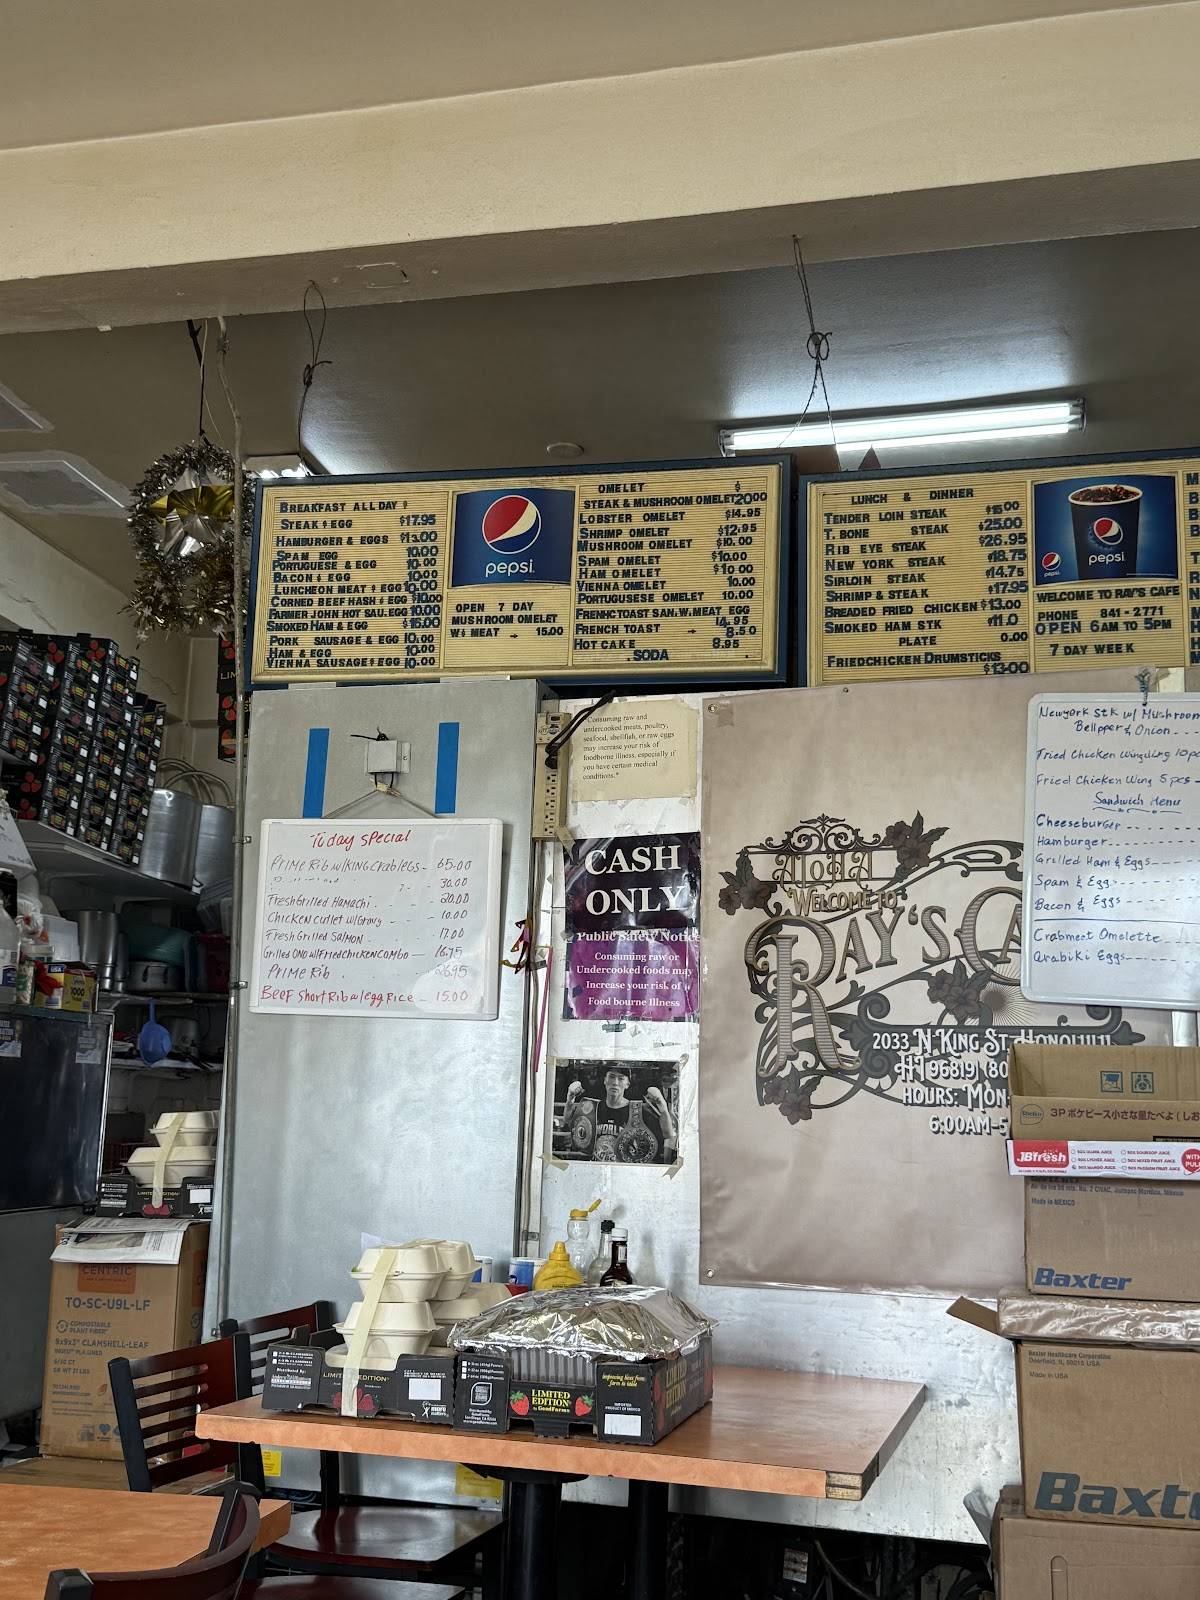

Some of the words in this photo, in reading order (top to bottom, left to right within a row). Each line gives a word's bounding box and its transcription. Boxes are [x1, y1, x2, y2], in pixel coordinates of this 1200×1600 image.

[598, 483, 645, 493] OMELET
[851, 495, 887, 505] LUNCH
[903, 493, 911, 501] &
[930, 488, 974, 500] DINNER
[280, 502, 346, 513] BREAKFAST
[353, 503, 375, 511] ALL
[378, 501, 398, 510] DAY
[281, 519, 319, 529] STEAK
[331, 520, 352, 528] EGG
[400, 514, 436, 526] $17.95
[580, 514, 632, 524] LOBSTER
[643, 512, 685, 521] OMELET
[725, 508, 760, 519] $14.95
[824, 513, 869, 524] TENDER
[879, 512, 903, 521] LOIN
[910, 509, 947, 519] STEAK
[580, 528, 622, 538] SHRIMP
[629, 528, 669, 536] OMELET
[718, 524, 757, 535] $12.95
[276, 536, 343, 547] HAMBURGER
[360, 535, 388, 544] EGGS
[577, 541, 643, 551] MUSHROOM
[649, 539, 692, 549] OMELET
[825, 544, 850, 555] RIB
[860, 544, 883, 553] EYE
[892, 542, 926, 552] STEAK
[979, 533, 1027, 547] $26.95
[825, 559, 854, 571] NEW
[863, 559, 894, 569] YORK
[908, 557, 945, 567] STEAK
[1089, 552, 1125, 565] pepsi
[486, 559, 533, 577] pepsi
[577, 581, 619, 592] VIENNA
[624, 581, 666, 591] OMELET
[727, 576, 755, 586] 10.00
[1037, 591, 1093, 602] WELCOME
[1100, 590, 1111, 599] TO
[1115, 588, 1146, 598] RAY'S
[1150, 586, 1180, 597] CAFE
[456, 604, 484, 612] OPEN
[499, 603, 504, 611] 7
[513, 602, 534, 611] DAY
[825, 606, 875, 617] BREADED
[882, 605, 913, 615] FRIED
[924, 602, 977, 613] CHICKEN
[452, 616, 513, 625] MUSHROOM
[518, 614, 557, 624] OMELET
[1038, 610, 1078, 621] PHONE
[576, 624, 619, 634] FRENCH
[624, 624, 660, 633] TOAST
[1035, 621, 1081, 635] OPEN
[1090, 620, 1118, 632] 6AM
[1124, 621, 1137, 630] TO
[1144, 618, 1171, 630] 5PM
[270, 636, 299, 646] PORK
[314, 637, 361, 645] SAUSAGE
[378, 635, 399, 644] EGG
[574, 640, 597, 650] HOT
[601, 640, 635, 649] CAKE
[712, 638, 739, 648] 8.95
[899, 637, 936, 646] PLATE
[269, 648, 293, 658] HAM
[310, 649, 331, 657] EGG
[633, 650, 669, 661] SODA
[1050, 644, 1059, 656] 7
[1064, 645, 1087, 655] DAY
[1094, 643, 1134, 654] WEEK
[267, 658, 311, 668] VIENNA
[317, 659, 366, 667] SAUSAGE
[378, 658, 400, 666] EGG
[1135, 725, 1170, 735] Onion
[1036, 748, 1066, 760] Fried
[1071, 749, 1116, 759] Chicken
[1036, 774, 1071, 785] Fried
[1076, 777, 1121, 785] Chicken
[1093, 792, 1144, 805] Sandwich
[1037, 835, 1108, 849] Hamburger
[585, 845, 681, 875] CASH
[1035, 854, 1080, 864] Grilled
[1087, 855, 1110, 867] Ham
[1125, 855, 1150, 871] Eggs
[1035, 875, 1069, 891] Spam
[440, 893, 469, 904] 20.00
[586, 886, 685, 915] ONLY
[1034, 898, 1071, 911] Bacon
[1093, 895, 1120, 908] Eggs
[442, 910, 468, 919] 10.00
[439, 928, 464, 939] 17.00
[577, 931, 615, 942] Public
[618, 931, 657, 943] Safety
[1099, 929, 1162, 942] Omelette
[595, 952, 646, 962] Consuming
[669, 953, 679, 961] or
[1098, 950, 1125, 964] Eggs
[577, 966, 640, 974] Undercooked
[643, 966, 670, 974] foods
[672, 968, 693, 976] may
[586, 981, 625, 989] Increase
[627, 982, 648, 991] your
[651, 981, 669, 989] risk
[671, 981, 682, 990] of
[745, 903, 951, 1078] RAY'S
[588, 997, 612, 1006] Food
[614, 998, 647, 1006] bourne
[650, 998, 680, 1007] Illness
[872, 1033, 910, 1050] 2033
[902, 1087, 958, 1105] HOURS:
[1017, 1150, 1066, 1163] JBfresh
[81, 1266, 133, 1276] CENTRIC
[1034, 1268, 1132, 1291] Baxter
[65, 1297, 151, 1311] TO-SC-U9L-LF
[532, 1389, 570, 1399] LIMITED
[532, 1398, 569, 1406] EDITION
